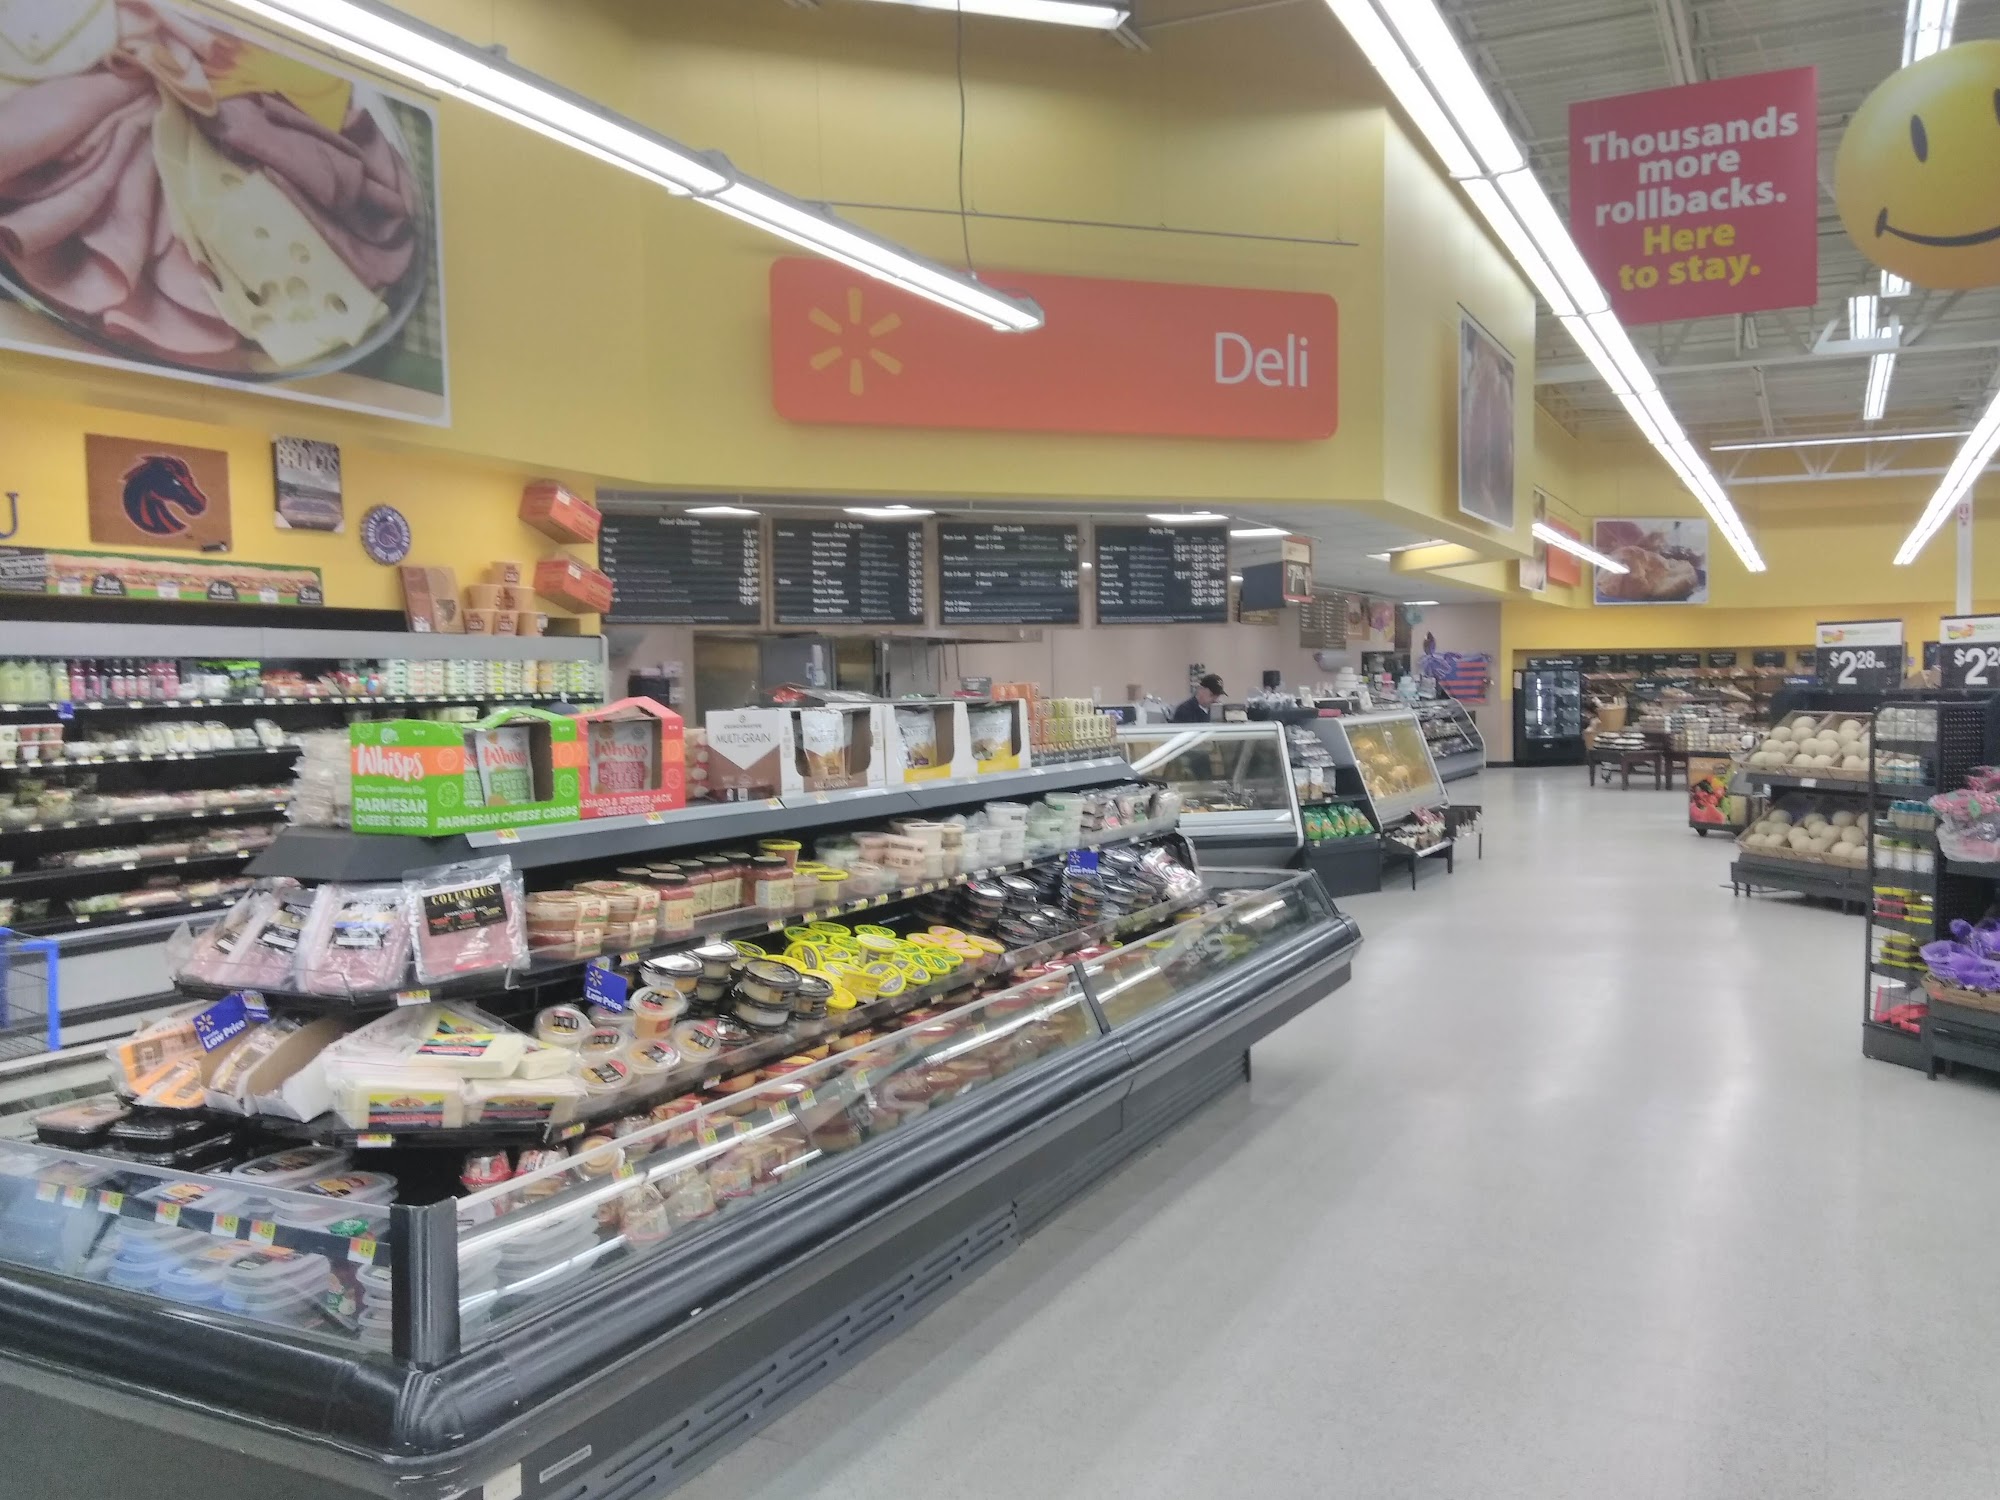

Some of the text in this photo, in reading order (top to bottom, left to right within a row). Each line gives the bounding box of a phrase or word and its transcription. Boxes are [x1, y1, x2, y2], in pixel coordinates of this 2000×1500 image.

[1584, 106, 1799, 164] Thousands
[1638, 147, 1740, 184] more
[1596, 178, 1787, 227] rollbacks.
[1643, 222, 1735, 256] Here
[1619, 253, 1761, 291] to stay.
[1214, 331, 1308, 387] Deli
[357, 742, 425, 782] Whisps
[355, 797, 428, 813] PARMESAN
[355, 814, 429, 828] CHEESE CRISPS
[436, 805, 579, 829] PARMESAN CHEESE CRISPS
[431, 885, 497, 906] COLUMBUS
[203, 1032, 225, 1049] Low
[222, 1019, 246, 1038] Price
